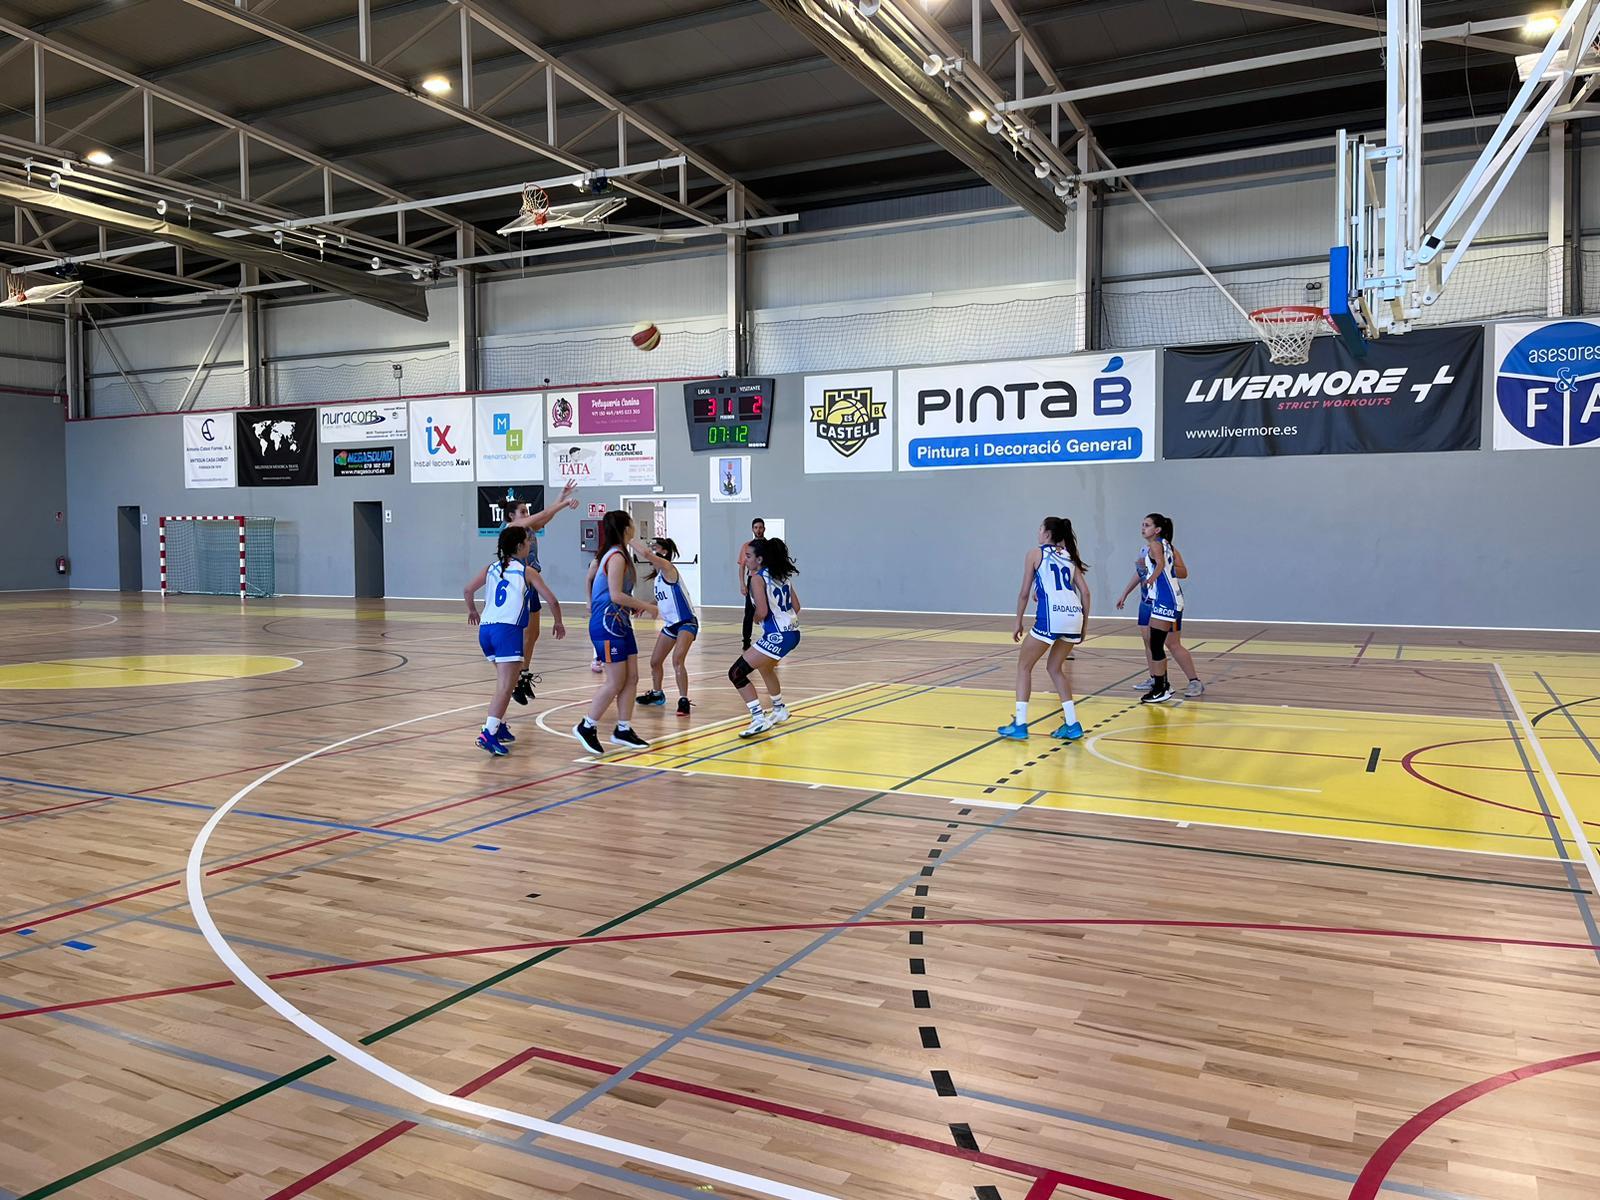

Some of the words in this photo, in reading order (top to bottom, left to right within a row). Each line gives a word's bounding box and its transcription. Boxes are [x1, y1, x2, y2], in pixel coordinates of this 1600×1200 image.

[1528, 345, 1600, 363] asesores
[1185, 367, 1408, 403] LIVERMORE
[707, 398, 717, 417] 3
[752, 395, 763, 414] 2
[1276, 400, 1320, 411] STRICT
[1322, 397, 1393, 408] WORKOUTS
[322, 409, 378, 425] nuracom
[708, 425, 748, 444] 07:12
[819, 422, 877, 439] CASTELL
[1185, 425, 1298, 439] www.livermore.es
[917, 445, 970, 460] Pintura
[974, 443, 979, 457] i
[983, 439, 1061, 457] Decoració
[1066, 436, 1132, 453] General
[455, 458, 471, 466] Xavi
[559, 454, 571, 463] EL
[559, 463, 590, 475] TATA
[1050, 563, 1073, 591] 10
[494, 579, 510, 608] 6
[772, 584, 793, 612] 22
[1052, 604, 1083, 613] BADALON
